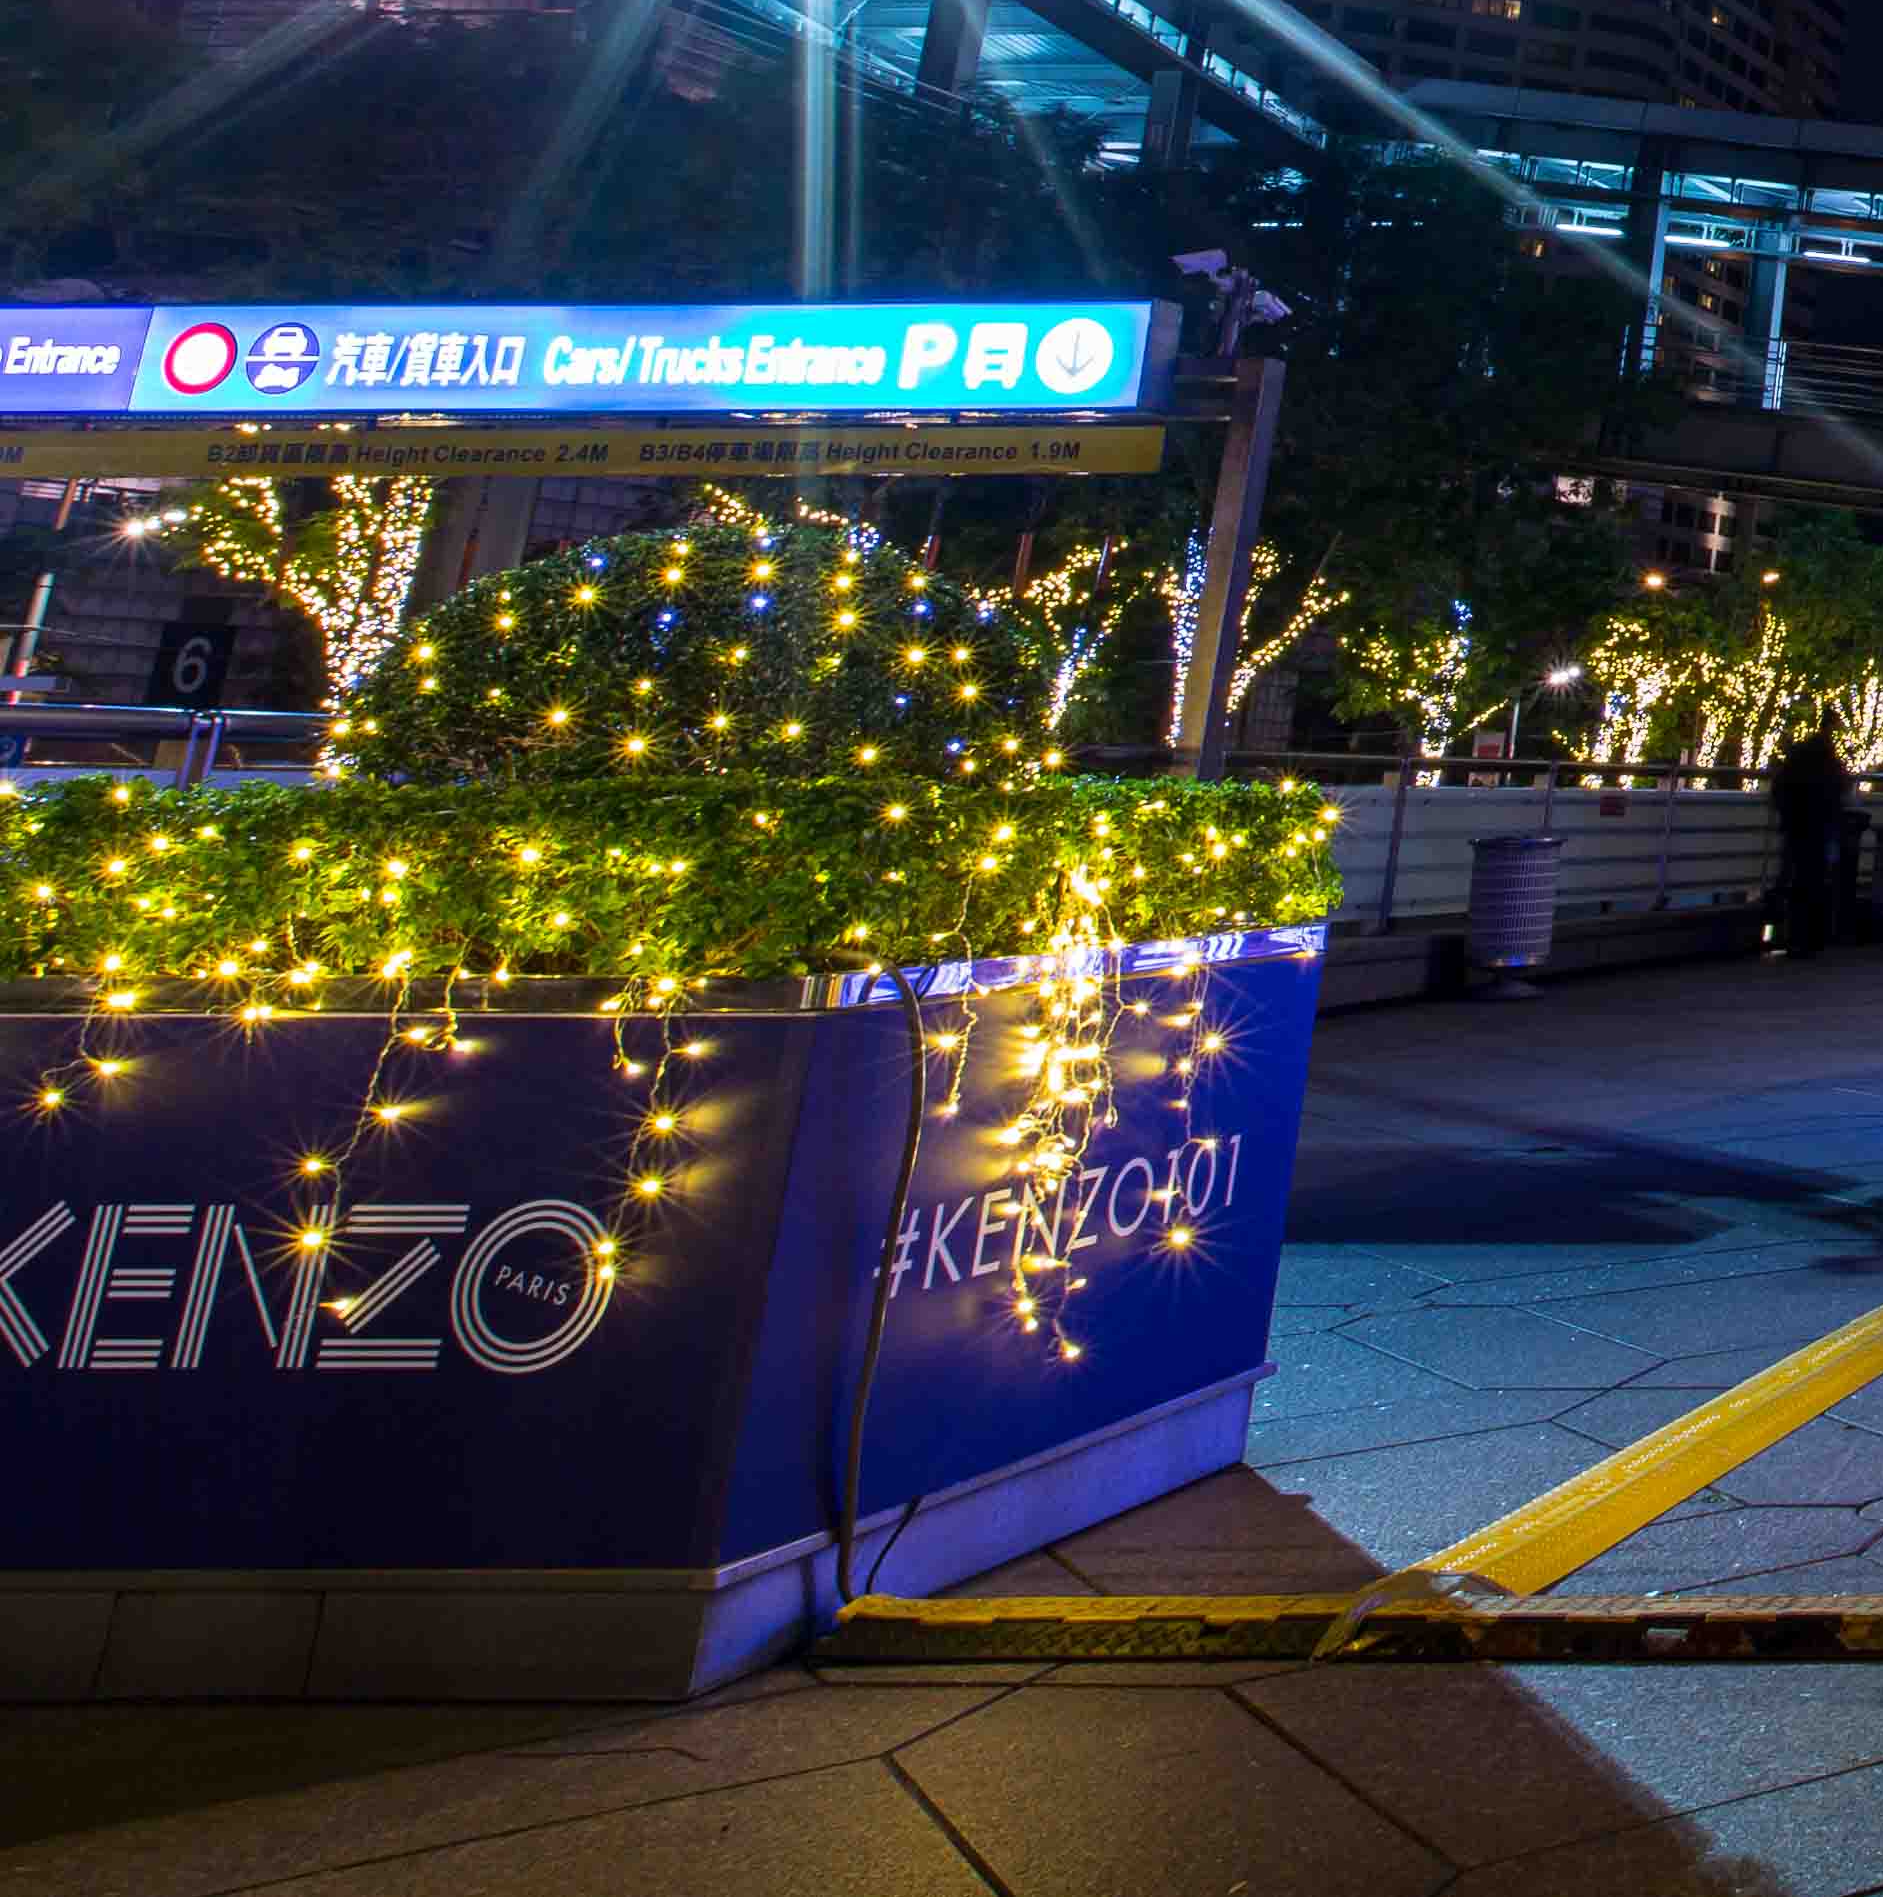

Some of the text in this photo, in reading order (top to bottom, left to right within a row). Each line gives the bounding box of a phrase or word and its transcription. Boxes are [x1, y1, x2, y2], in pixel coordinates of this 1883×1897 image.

[4, 336, 121, 375] Entrance
[743, 335, 886, 384] Entrance
[355, 444, 428, 468] Height
[431, 445, 546, 464] Clearance
[554, 444, 609, 464] 2.4M
[826, 441, 898, 464] Height
[904, 441, 1018, 461] Clearance
[1030, 441, 1081, 461] 1.9M
[173, 637, 211, 693] 6
[872, 1134, 1243, 1299] #KENZO101
[495, 1264, 572, 1305] PARIS
